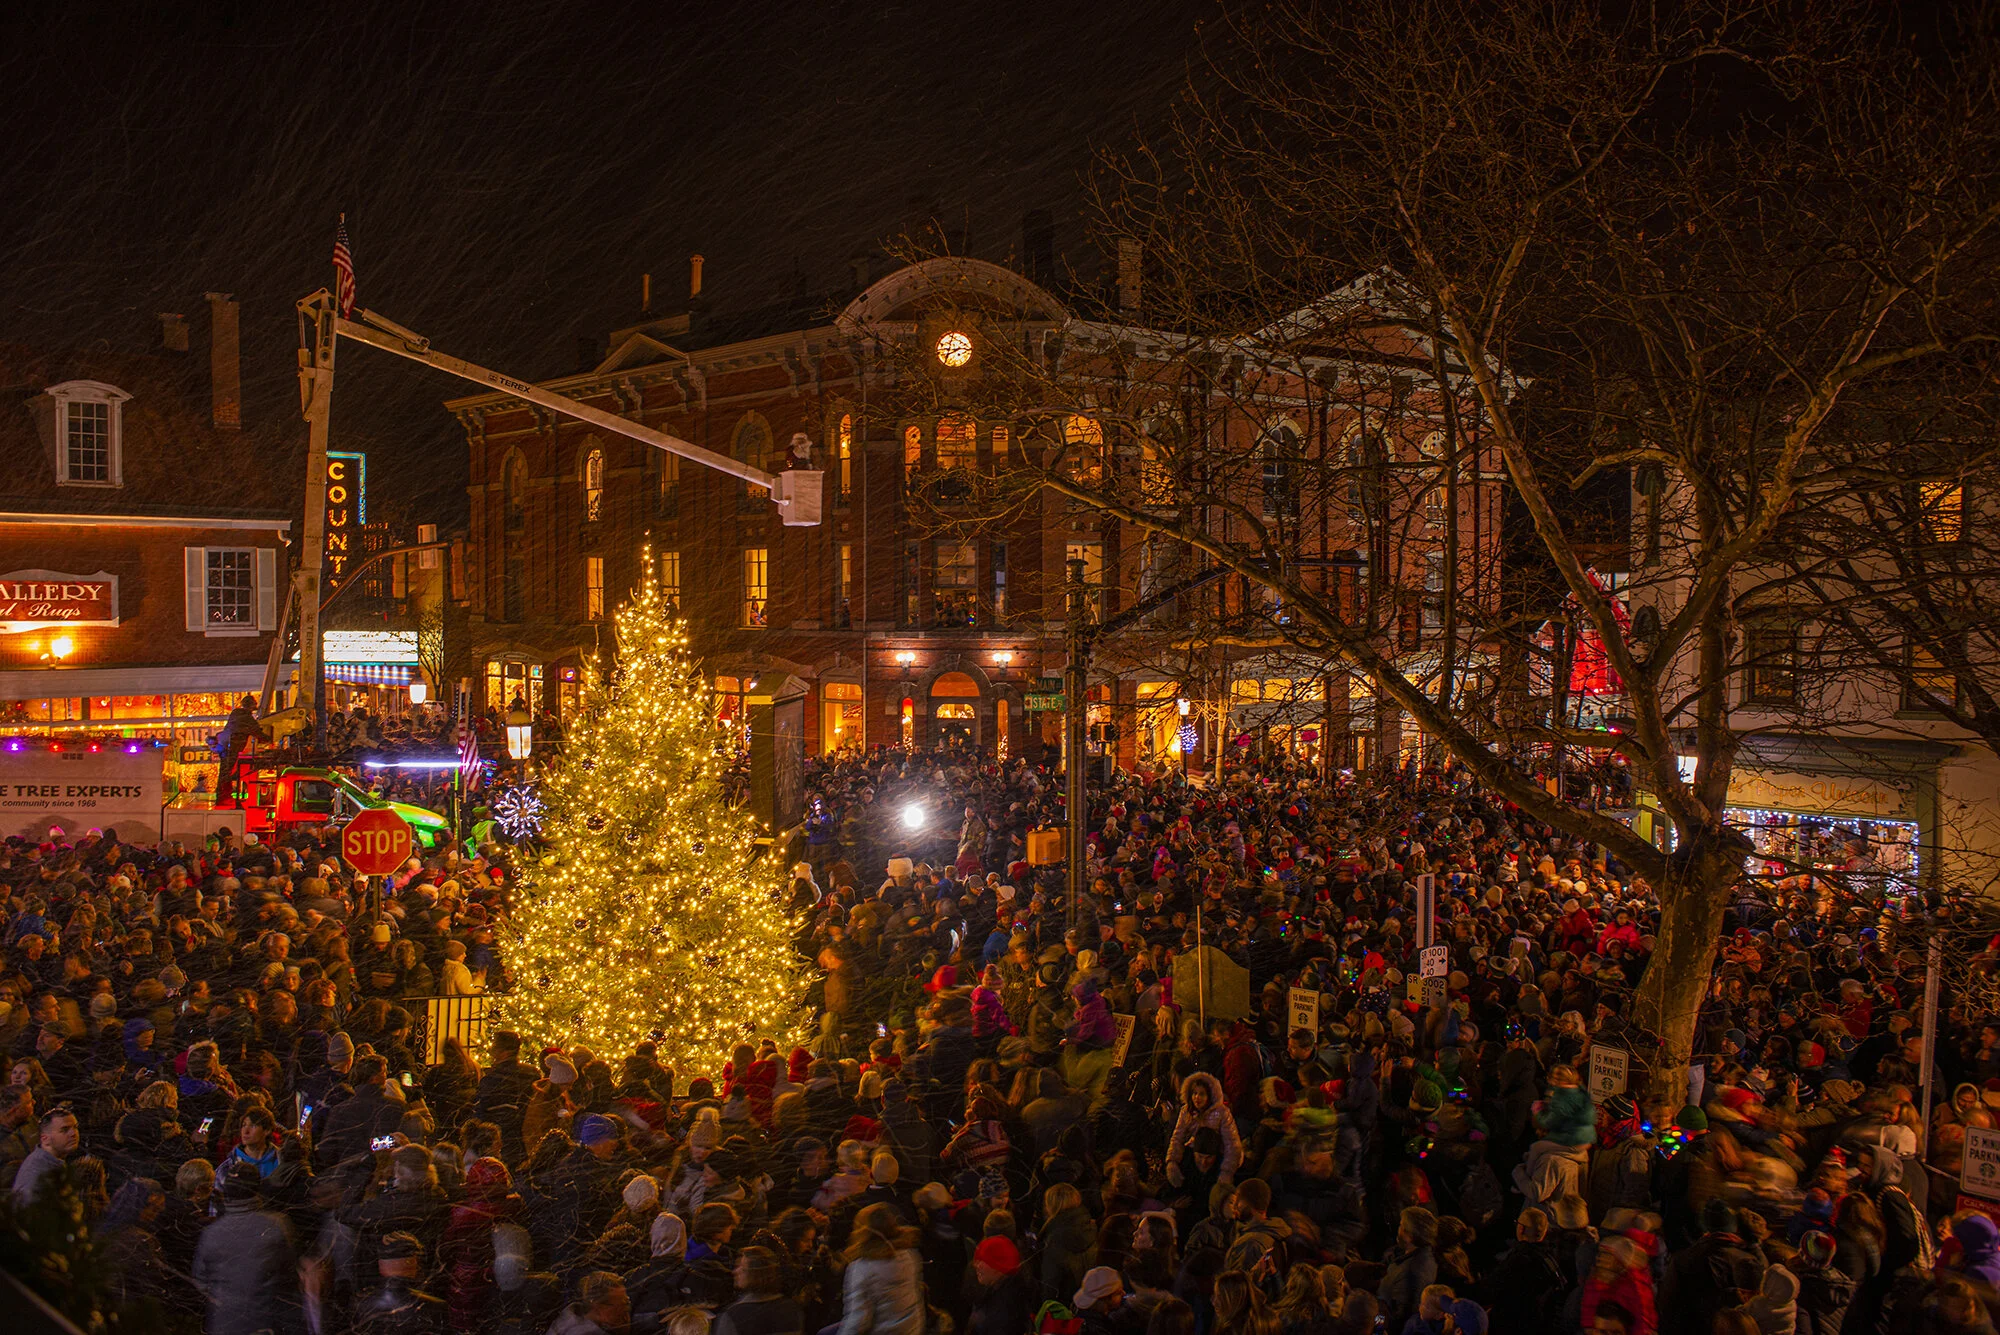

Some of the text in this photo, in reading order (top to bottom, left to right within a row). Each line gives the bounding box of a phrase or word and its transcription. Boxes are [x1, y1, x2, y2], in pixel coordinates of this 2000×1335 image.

[499, 377, 531, 394] TEREX
[28, 602, 81, 619] Rugs
[305, 625, 314, 659] TEREX
[1032, 697, 1056, 709] STATE
[175, 728, 209, 747] SALE
[184, 751, 211, 762] OFF
[14, 785, 60, 797] TREE
[66, 785, 142, 798] EXPERTS
[1810, 781, 1889, 805] Unicorn
[2, 800, 97, 808] community since 1968
[347, 829, 407, 856] STOP
[1429, 947, 1446, 957] 1001
[1408, 974, 1445, 990] SR 3002
[1294, 1002, 1313, 1013] PARKING
[1299, 994, 1316, 1005] MINUTE
[1595, 1053, 1623, 1069] 15 MINUTE
[1593, 1064, 1623, 1080] PARKING
[1970, 1134, 1979, 1147] 15
